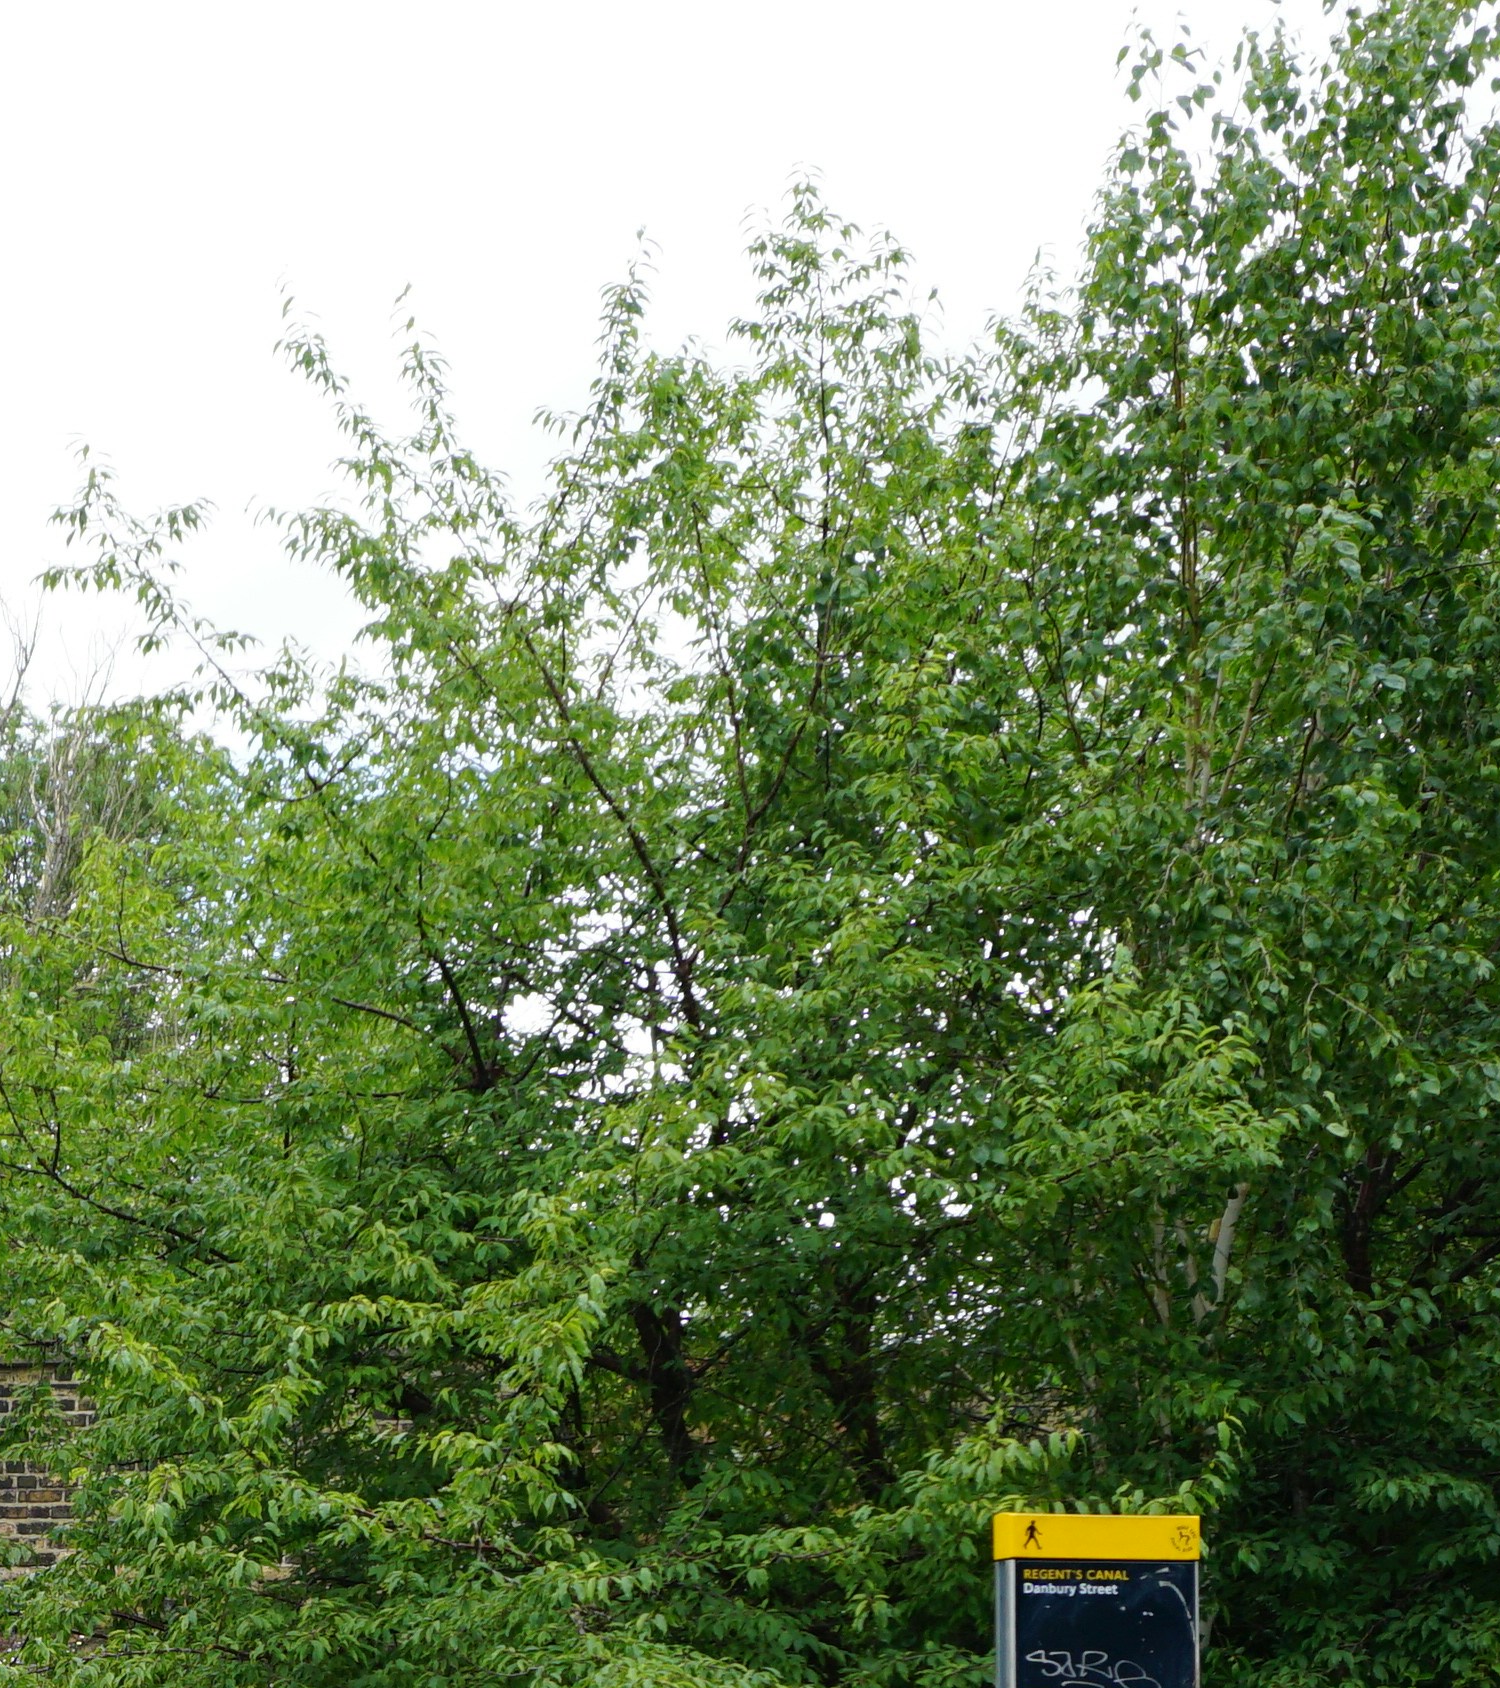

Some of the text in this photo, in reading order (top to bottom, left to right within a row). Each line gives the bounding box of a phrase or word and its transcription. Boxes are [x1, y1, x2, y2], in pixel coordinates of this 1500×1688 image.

[1023, 1569, 1129, 1581] REGENT'S CANAL
[1023, 1583, 1118, 1597] Danbury Street
